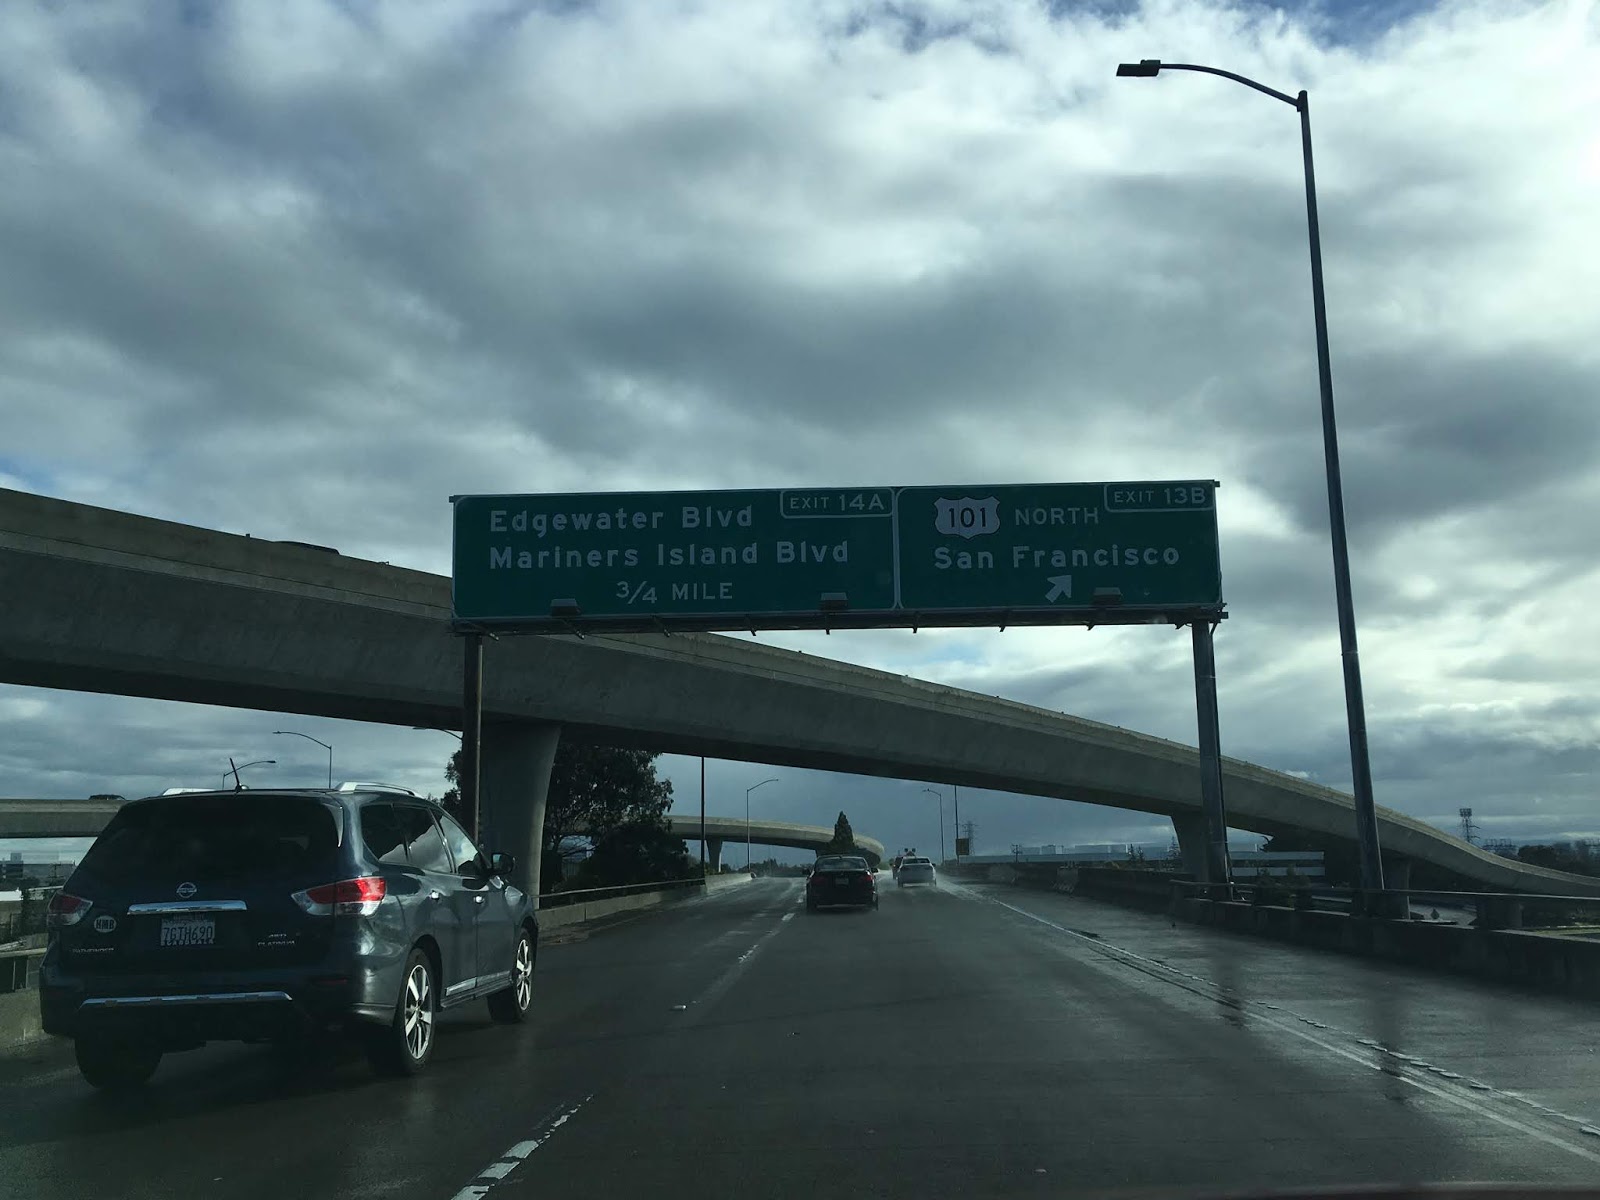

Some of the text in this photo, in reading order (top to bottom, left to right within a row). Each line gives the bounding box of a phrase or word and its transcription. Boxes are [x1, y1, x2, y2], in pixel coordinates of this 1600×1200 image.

[789, 493, 886, 511] EXIT 14A
[1113, 487, 1206, 505] EXIT 13B
[489, 504, 752, 538] Edgewater Blvd
[948, 507, 988, 529] 101
[1015, 507, 1099, 526] NORTH
[489, 540, 849, 569] Mariners Island Blvd
[934, 543, 1180, 570] San Francisco
[615, 580, 734, 605] 3/4 MILE
